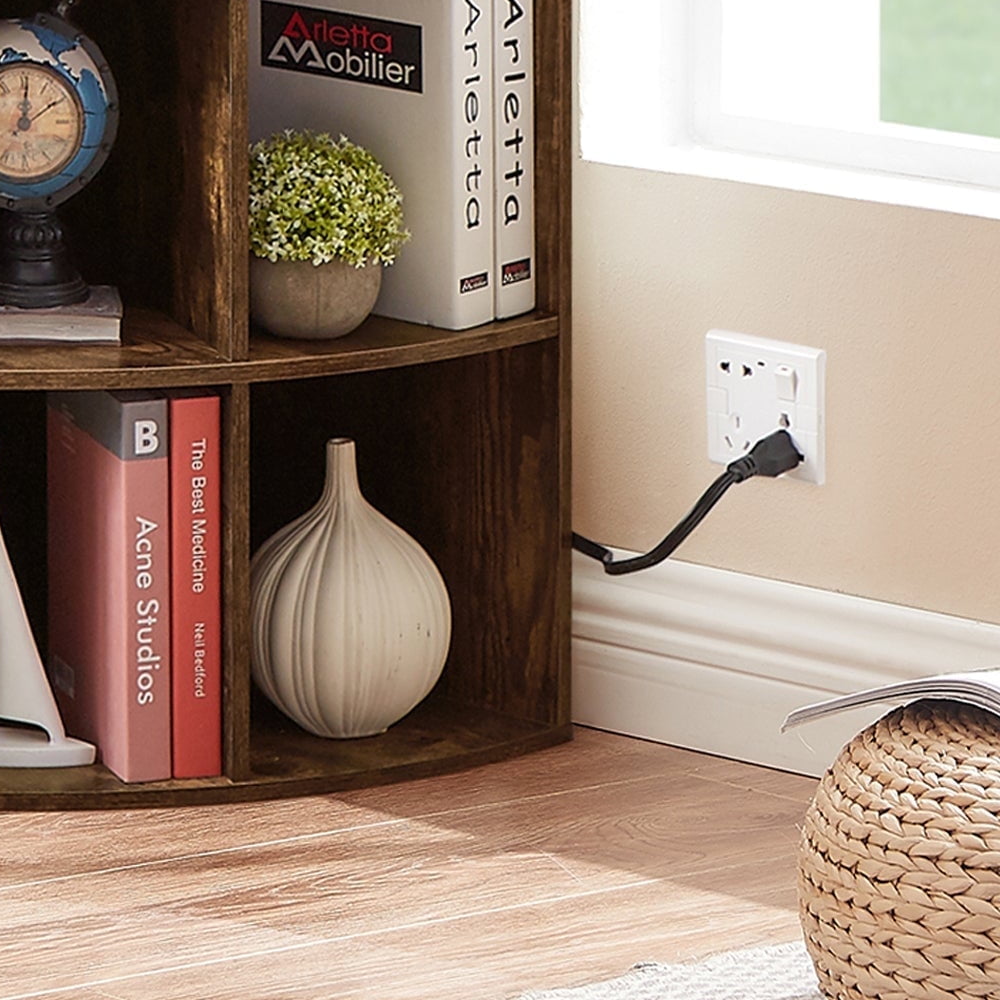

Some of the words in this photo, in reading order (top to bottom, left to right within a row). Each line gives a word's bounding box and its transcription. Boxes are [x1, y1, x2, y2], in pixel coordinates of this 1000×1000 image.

[281, 10, 393, 54] Arletta
[267, 34, 416, 86] Mobilier
[134, 420, 159, 455] B
[191, 438, 207, 471] The
[191, 477, 207, 515] Best
[135, 517, 159, 590] Acne
[191, 518, 207, 594] Medicine
[136, 599, 160, 706] Studios
[194, 622, 206, 648] Neil
[194, 649, 206, 698] Bedford
